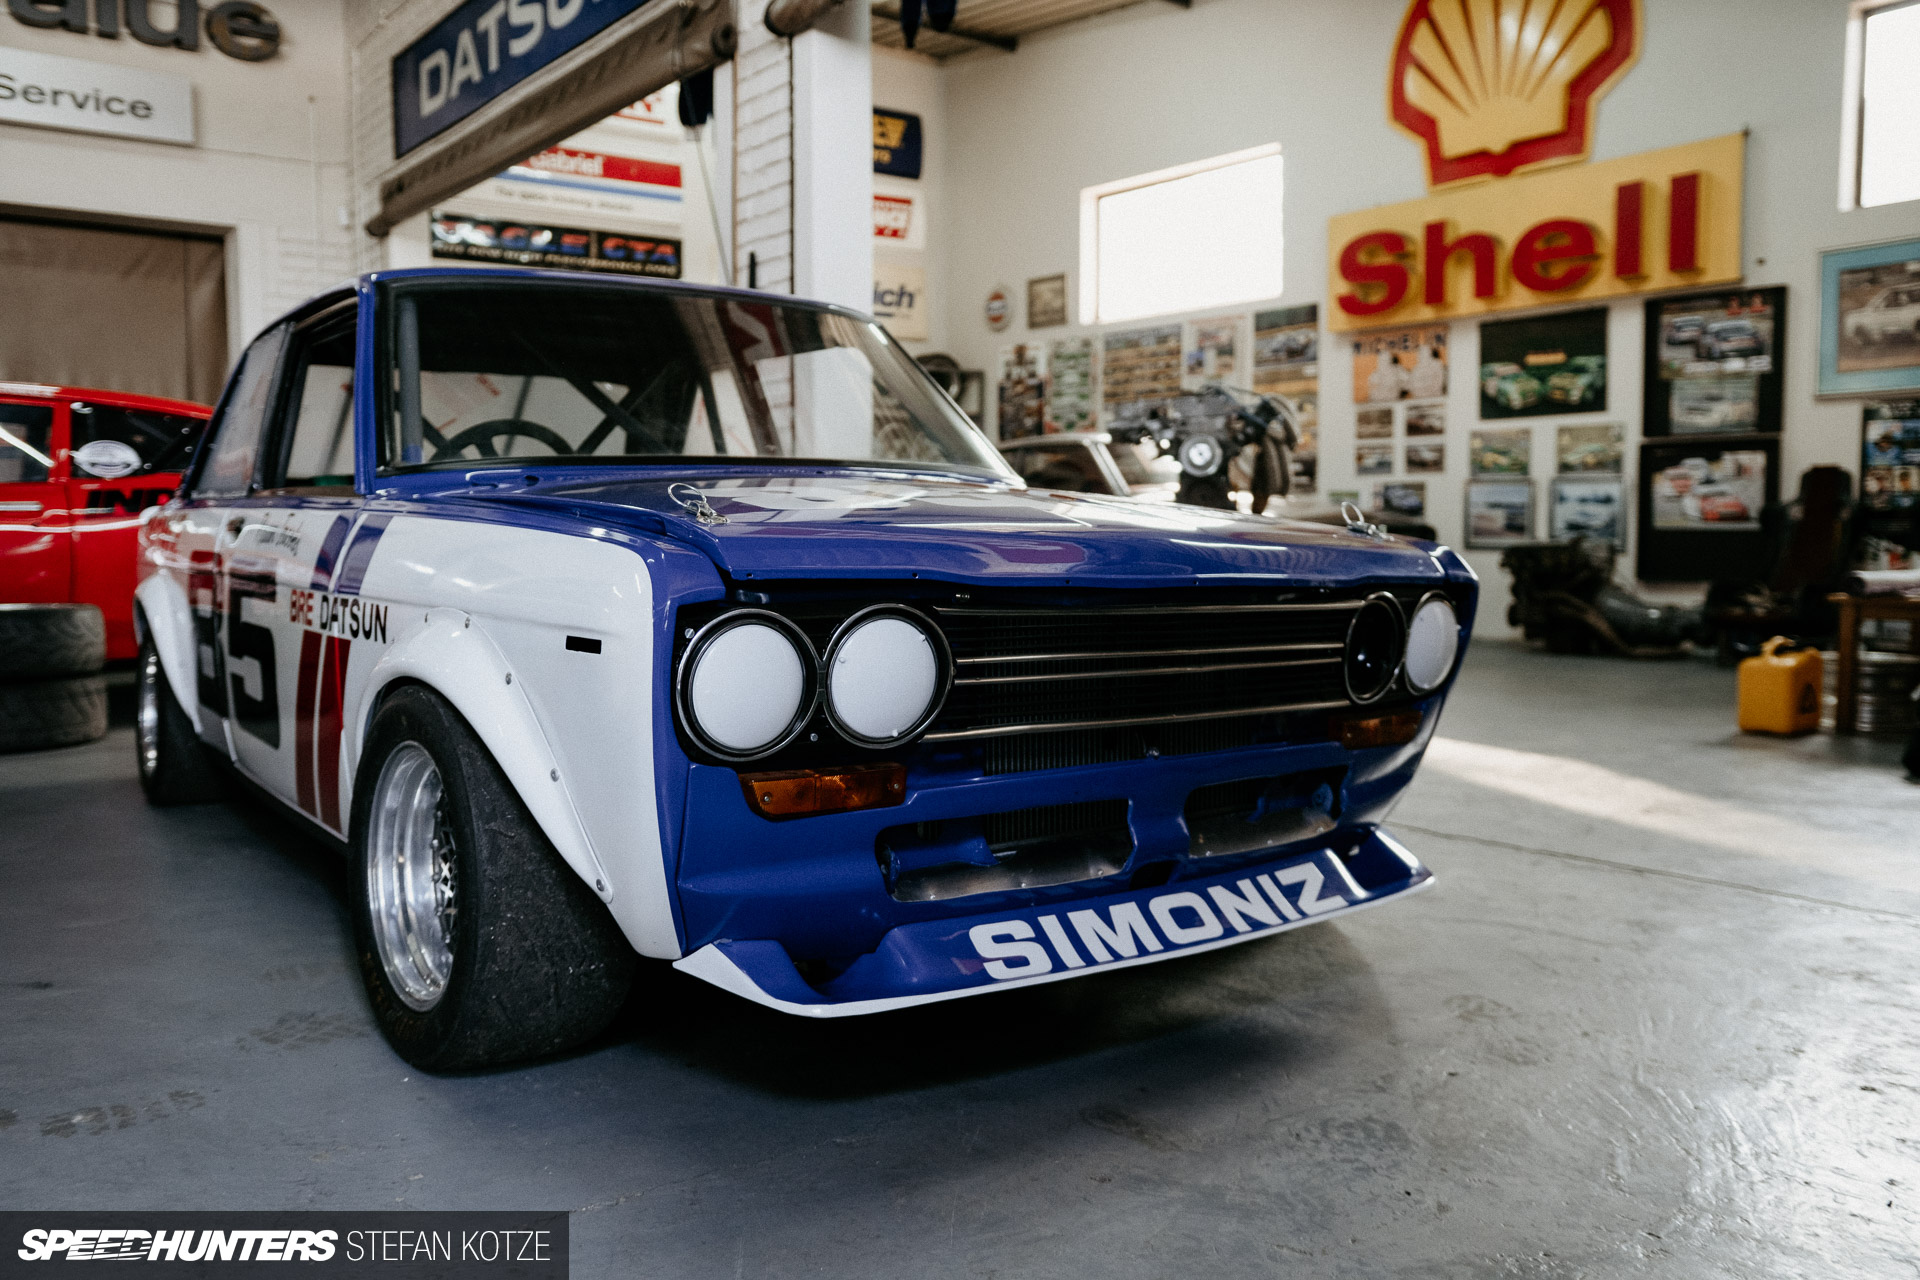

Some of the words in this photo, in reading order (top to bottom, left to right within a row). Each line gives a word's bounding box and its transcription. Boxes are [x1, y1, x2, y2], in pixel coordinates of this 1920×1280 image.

[0, 73, 153, 118] Service
[1337, 172, 1699, 316] shell
[290, 588, 315, 627] BRE
[320, 594, 388, 645] DATSUN
[968, 861, 1350, 981] SIMONIZ
